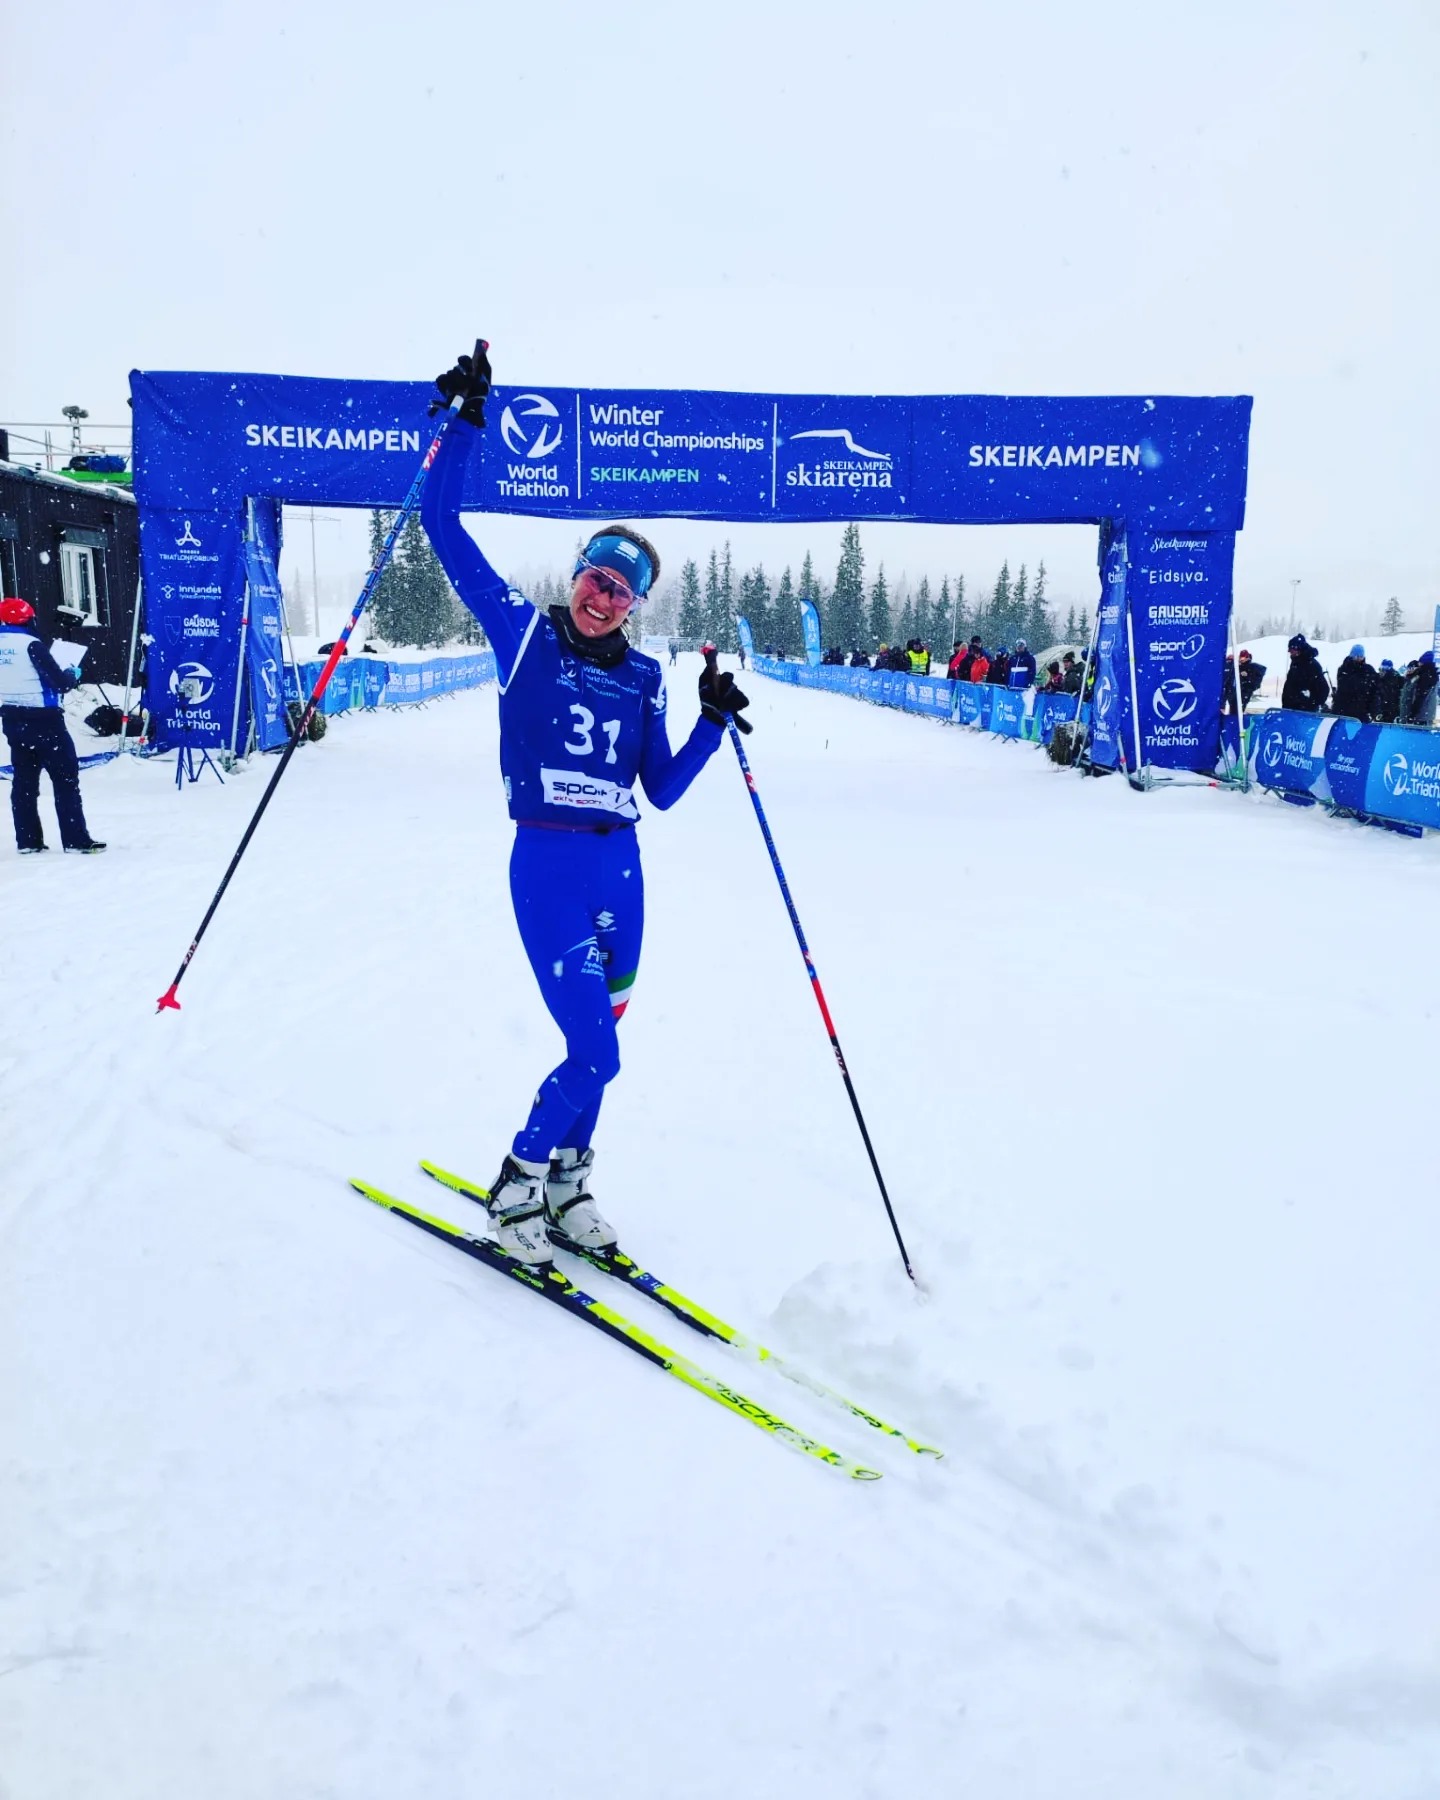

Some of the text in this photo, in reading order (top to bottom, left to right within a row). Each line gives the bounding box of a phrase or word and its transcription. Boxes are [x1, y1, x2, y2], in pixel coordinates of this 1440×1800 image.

[589, 403, 664, 426] Winter
[245, 424, 420, 452] SKEIKAMPEN
[589, 429, 765, 453] World Championships
[968, 445, 1140, 467] SKEIKAMPEN
[507, 463, 558, 481] World
[823, 460, 893, 471] SKEIKAMPEN
[590, 467, 700, 484] SKEIKAMPEN
[786, 463, 893, 488] skiarena
[496, 479, 569, 498] Triathlon
[1150, 537, 1208, 554] Skeikampen
[1148, 605, 1209, 619] GAUSDAL
[183, 617, 220, 629] GAUSDAL
[1149, 641, 1187, 654] sport
[564, 703, 621, 764] 31
[1153, 725, 1192, 736] World
[1145, 736, 1199, 747] Triathlon
[1286, 735, 1307, 753] World
